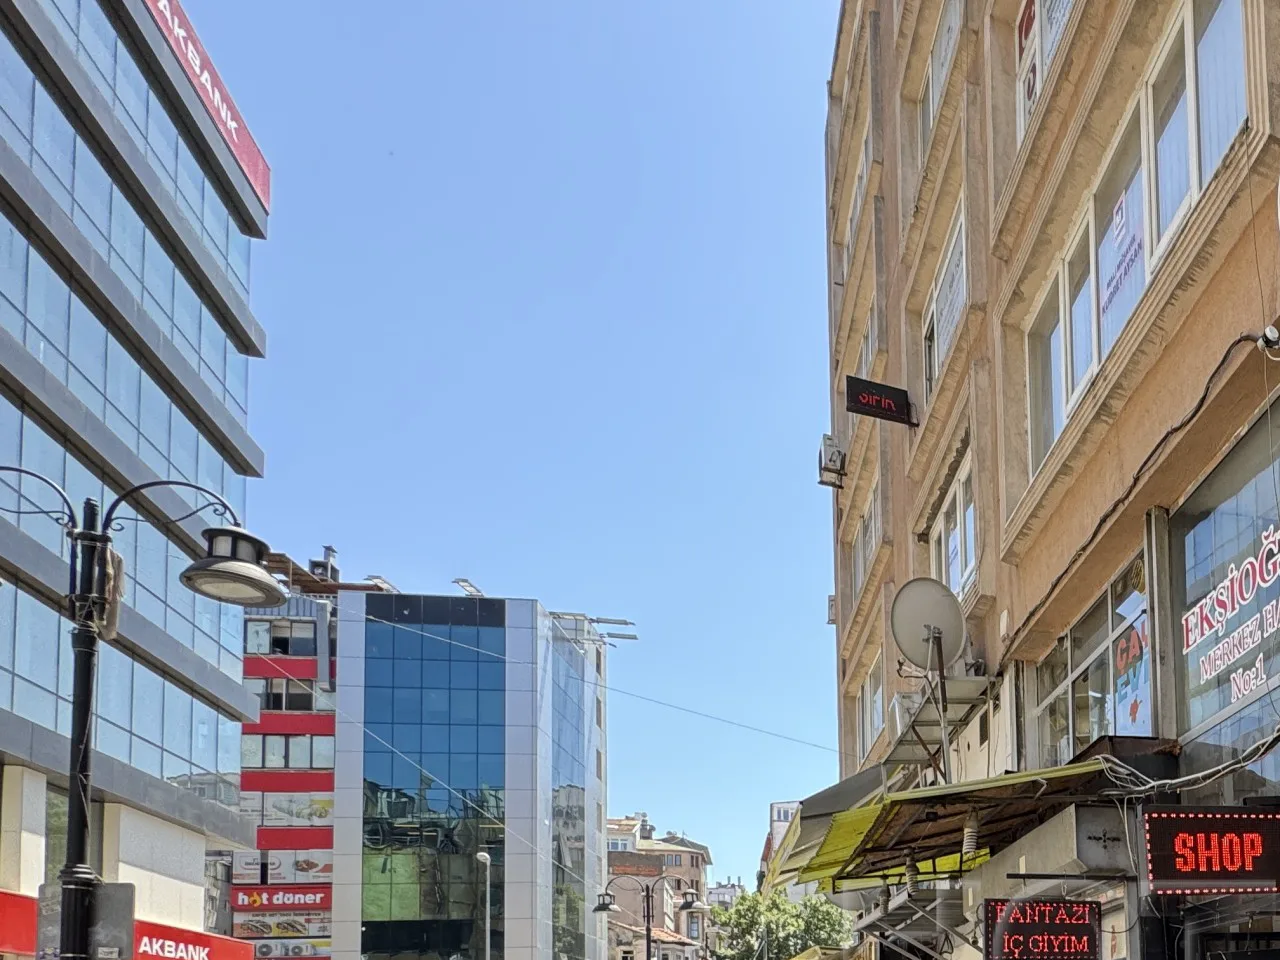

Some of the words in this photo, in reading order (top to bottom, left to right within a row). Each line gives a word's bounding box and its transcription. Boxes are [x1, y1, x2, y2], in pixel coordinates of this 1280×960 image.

[157, 0, 239, 143] AKBANK
[1199, 613, 1262, 685] MERKEZ
[1230, 652, 1267, 703] No:1
[1174, 832, 1263, 873] SHOP
[237, 891, 269, 907] hot
[272, 891, 325, 905] döner
[1028, 932, 1090, 953] GİYİM
